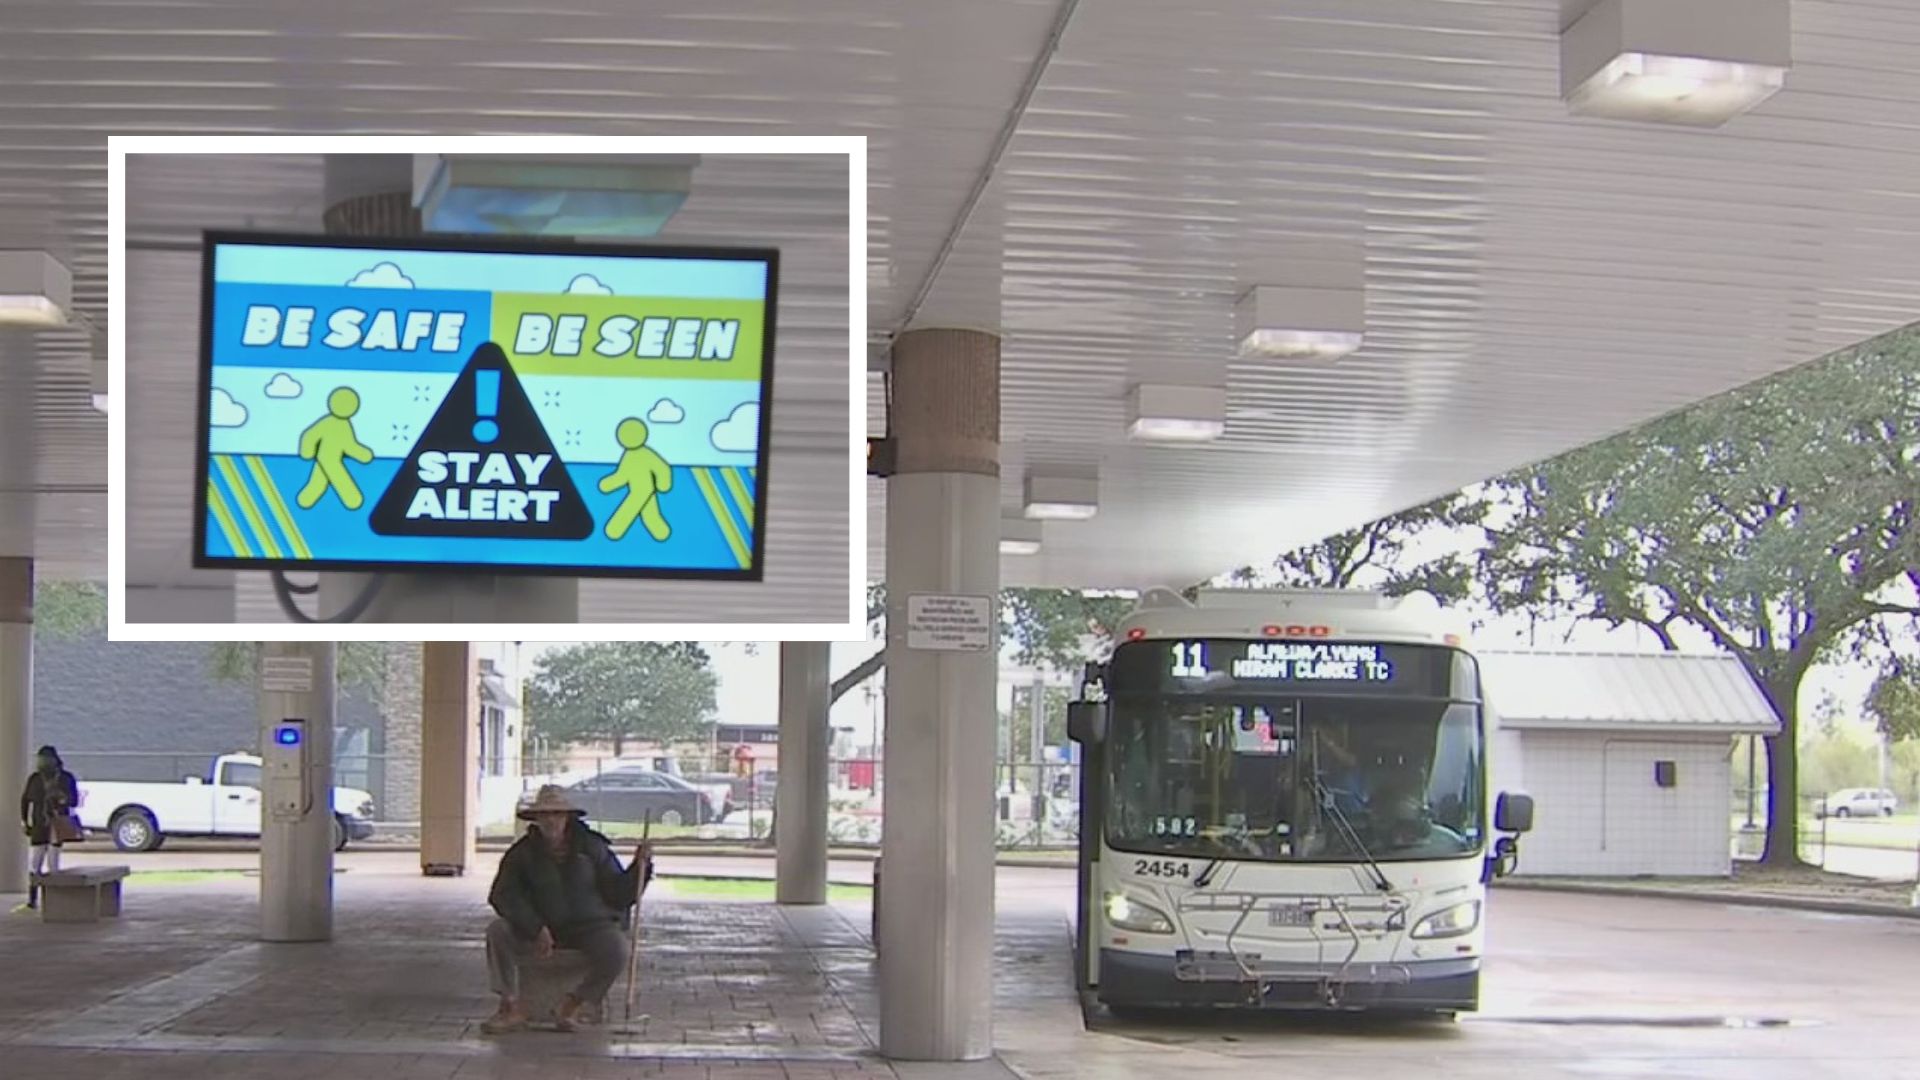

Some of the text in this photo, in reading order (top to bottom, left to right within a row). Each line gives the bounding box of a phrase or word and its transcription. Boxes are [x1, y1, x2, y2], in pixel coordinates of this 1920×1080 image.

[241, 305, 466, 353] BE SAFE
[513, 312, 740, 361] BE SEEN
[416, 450, 553, 486] STAY
[405, 488, 560, 522] ALERT
[1171, 642, 1207, 677] 11
[1295, 661, 1358, 679] CLARKE
[1366, 661, 1389, 679] TC
[1134, 860, 1190, 878] 2454
